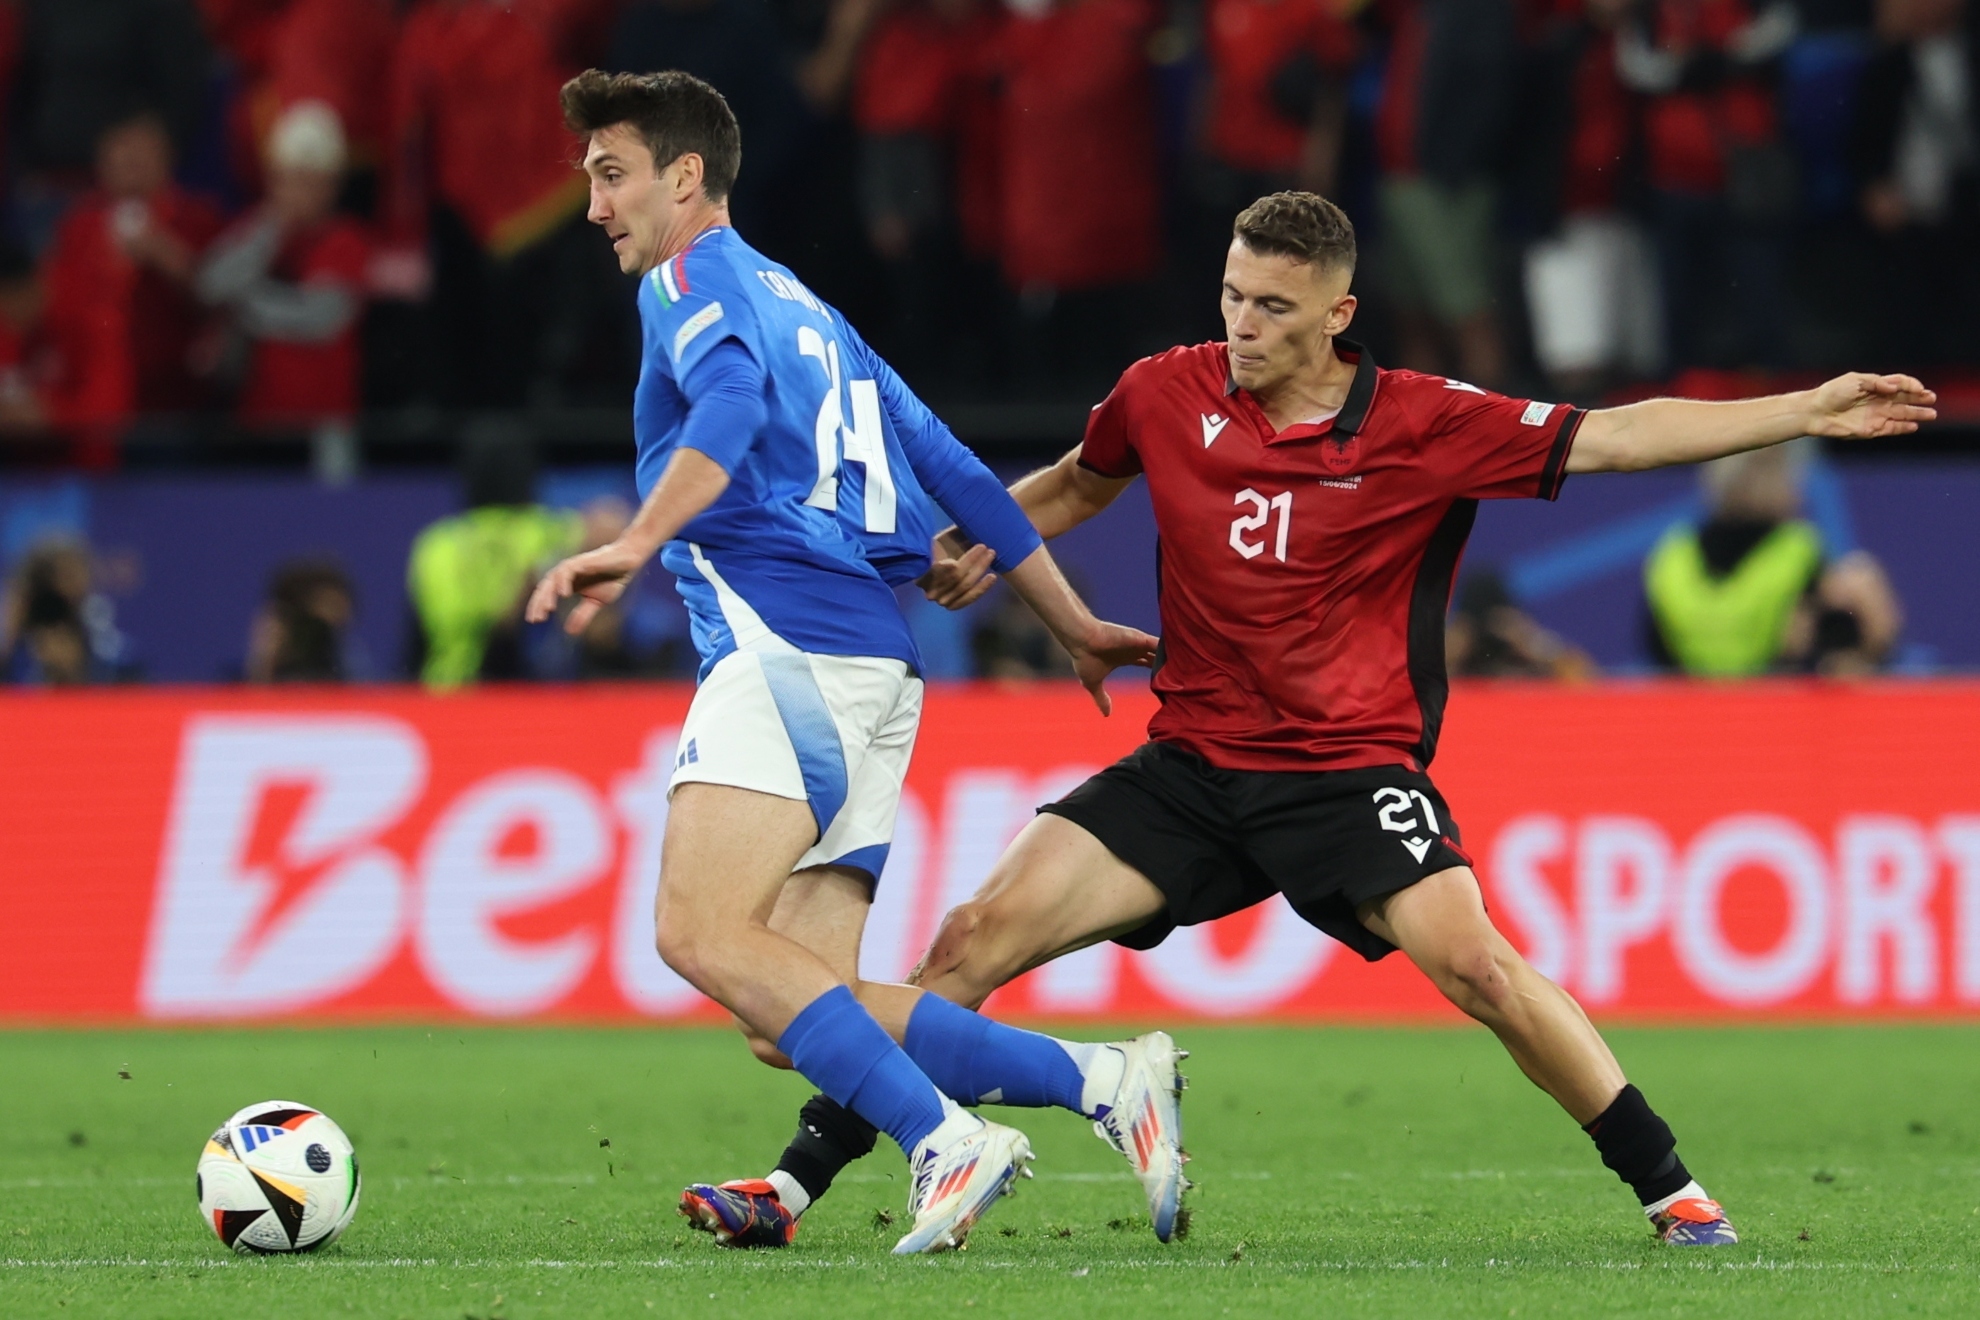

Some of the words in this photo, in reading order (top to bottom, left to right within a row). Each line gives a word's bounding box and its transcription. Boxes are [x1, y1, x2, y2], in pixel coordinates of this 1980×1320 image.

[798, 325, 897, 534] 24
[1319, 480, 1358, 490] 15/06/2024
[1228, 487, 1293, 563] 21
[1372, 786, 1440, 835] 21
